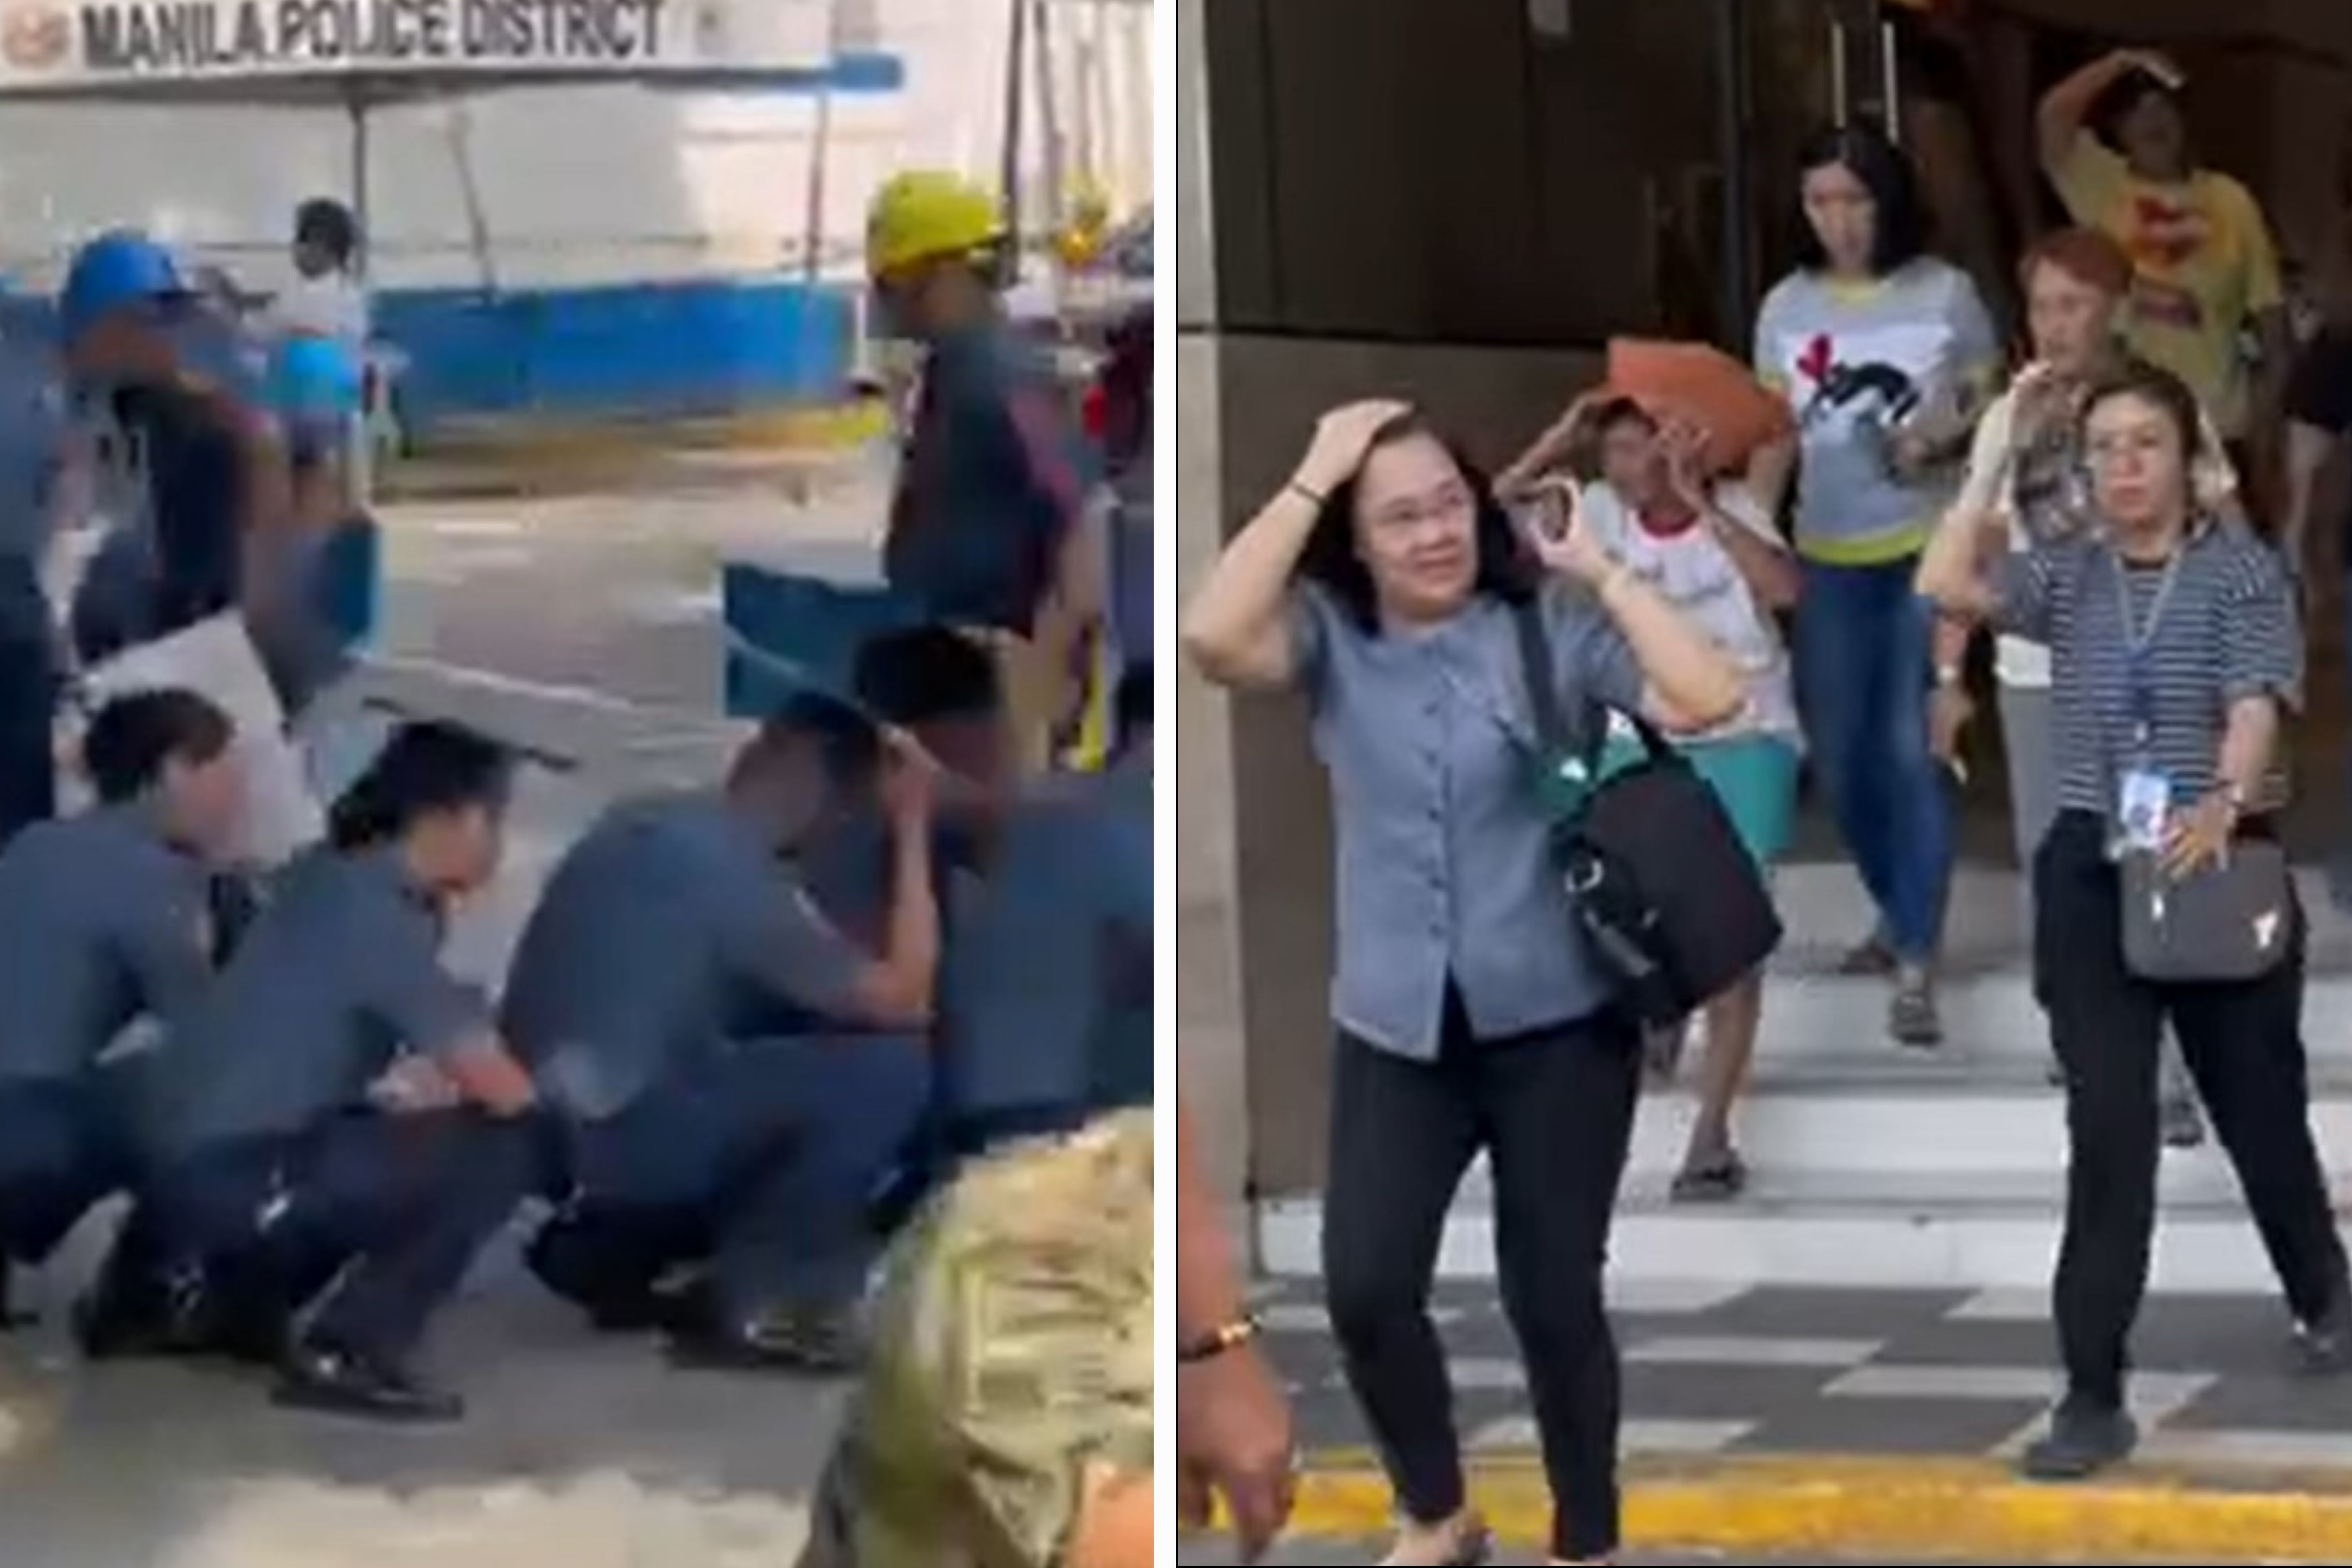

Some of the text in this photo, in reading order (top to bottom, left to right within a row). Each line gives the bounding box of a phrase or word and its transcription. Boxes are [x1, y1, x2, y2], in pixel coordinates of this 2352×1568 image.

[82, 0, 662, 67] MANILA POLICE DISTRICT
